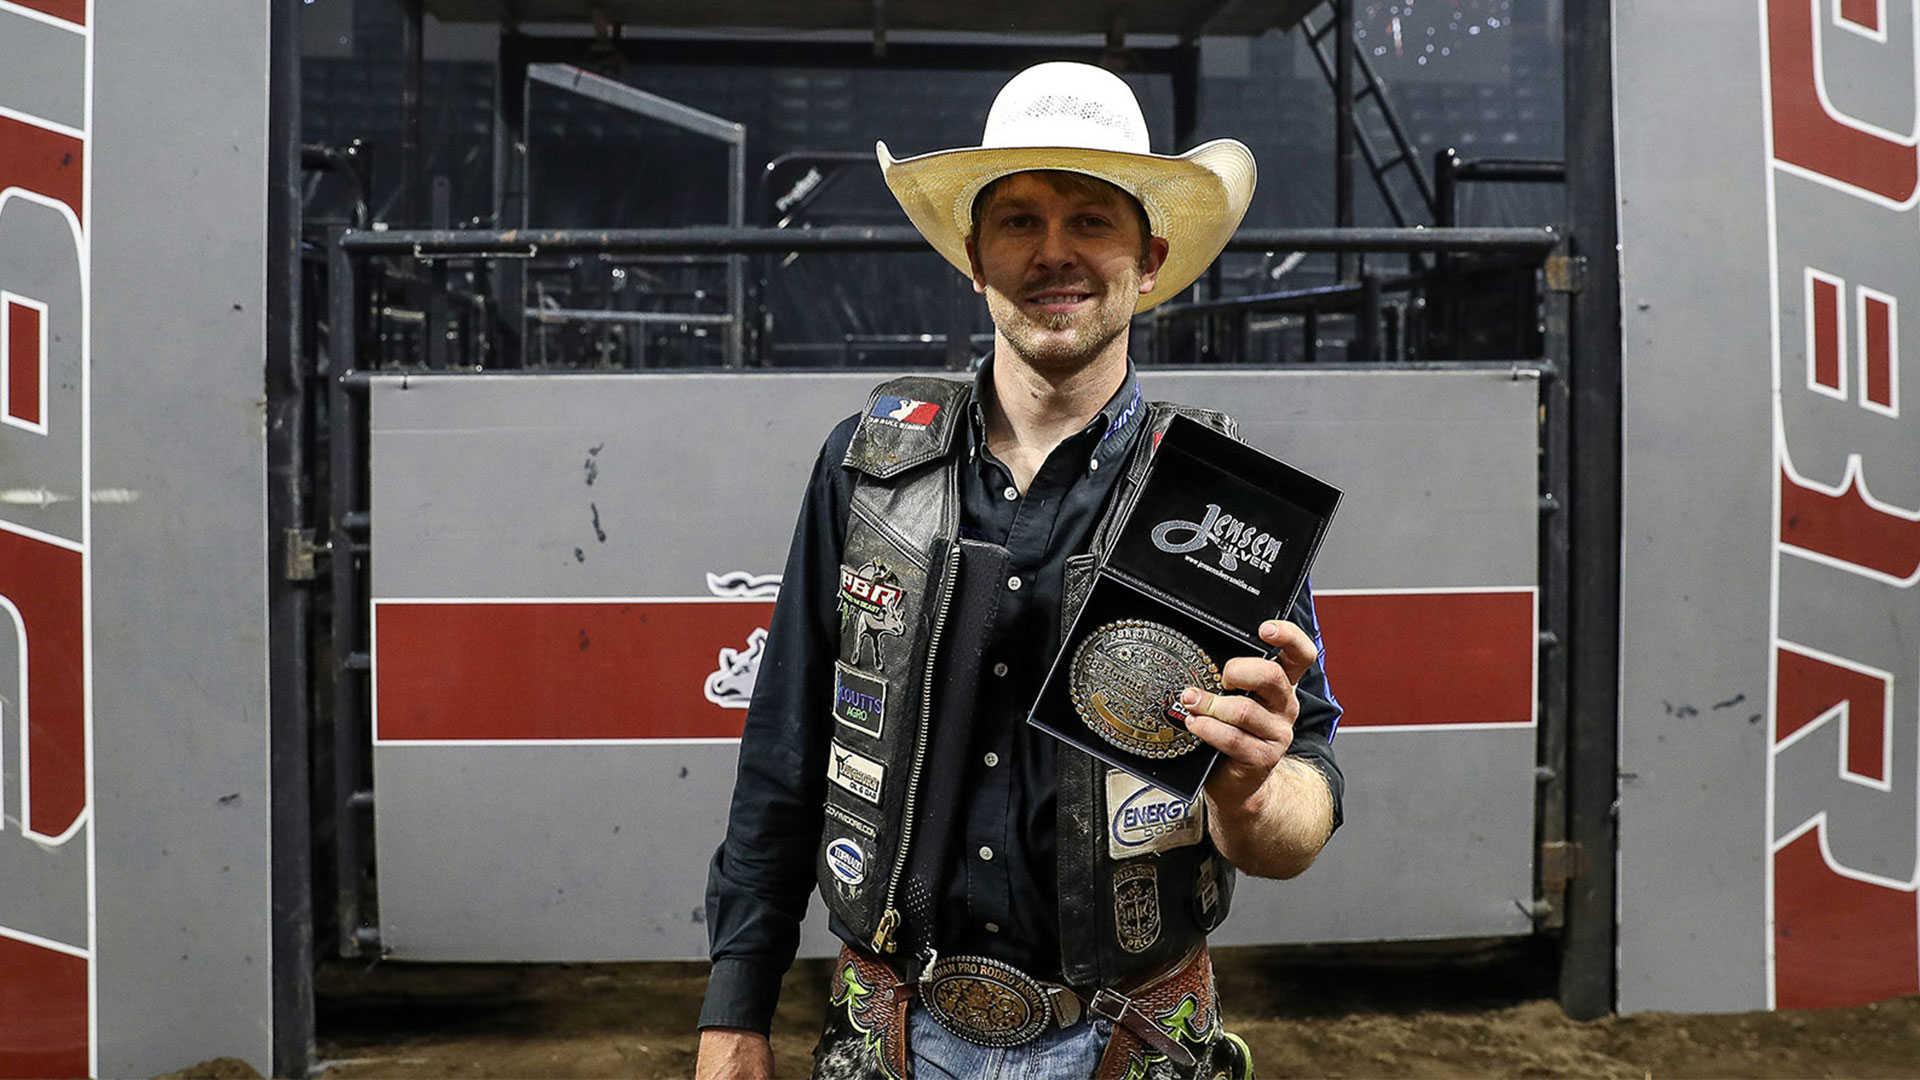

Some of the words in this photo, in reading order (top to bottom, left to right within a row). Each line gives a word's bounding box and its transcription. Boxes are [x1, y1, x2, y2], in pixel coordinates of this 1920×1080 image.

[1151, 503, 1283, 564] Jensen
[1216, 540, 1273, 574] SILVER
[841, 570, 897, 609] PBR
[1123, 800, 1191, 828] ENERGY
[957, 962, 978, 975] PRO
[979, 964, 1014, 986] RODEO
